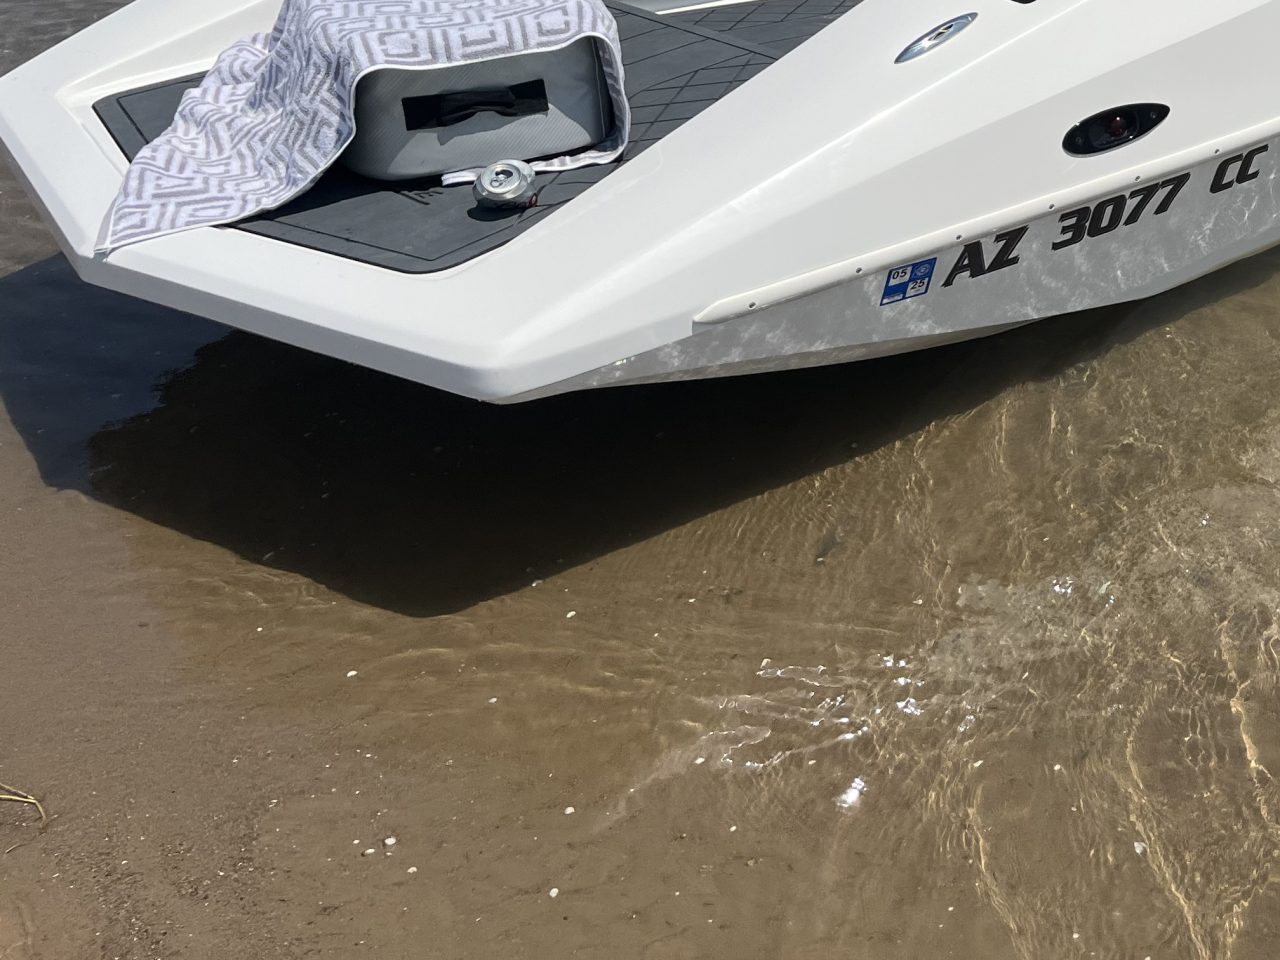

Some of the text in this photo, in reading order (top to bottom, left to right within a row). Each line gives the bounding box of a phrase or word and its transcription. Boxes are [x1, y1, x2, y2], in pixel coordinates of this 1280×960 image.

[941, 143, 1269, 288] AZ 3077 CC
[892, 268, 908, 280] 05
[909, 279, 925, 290] 25
